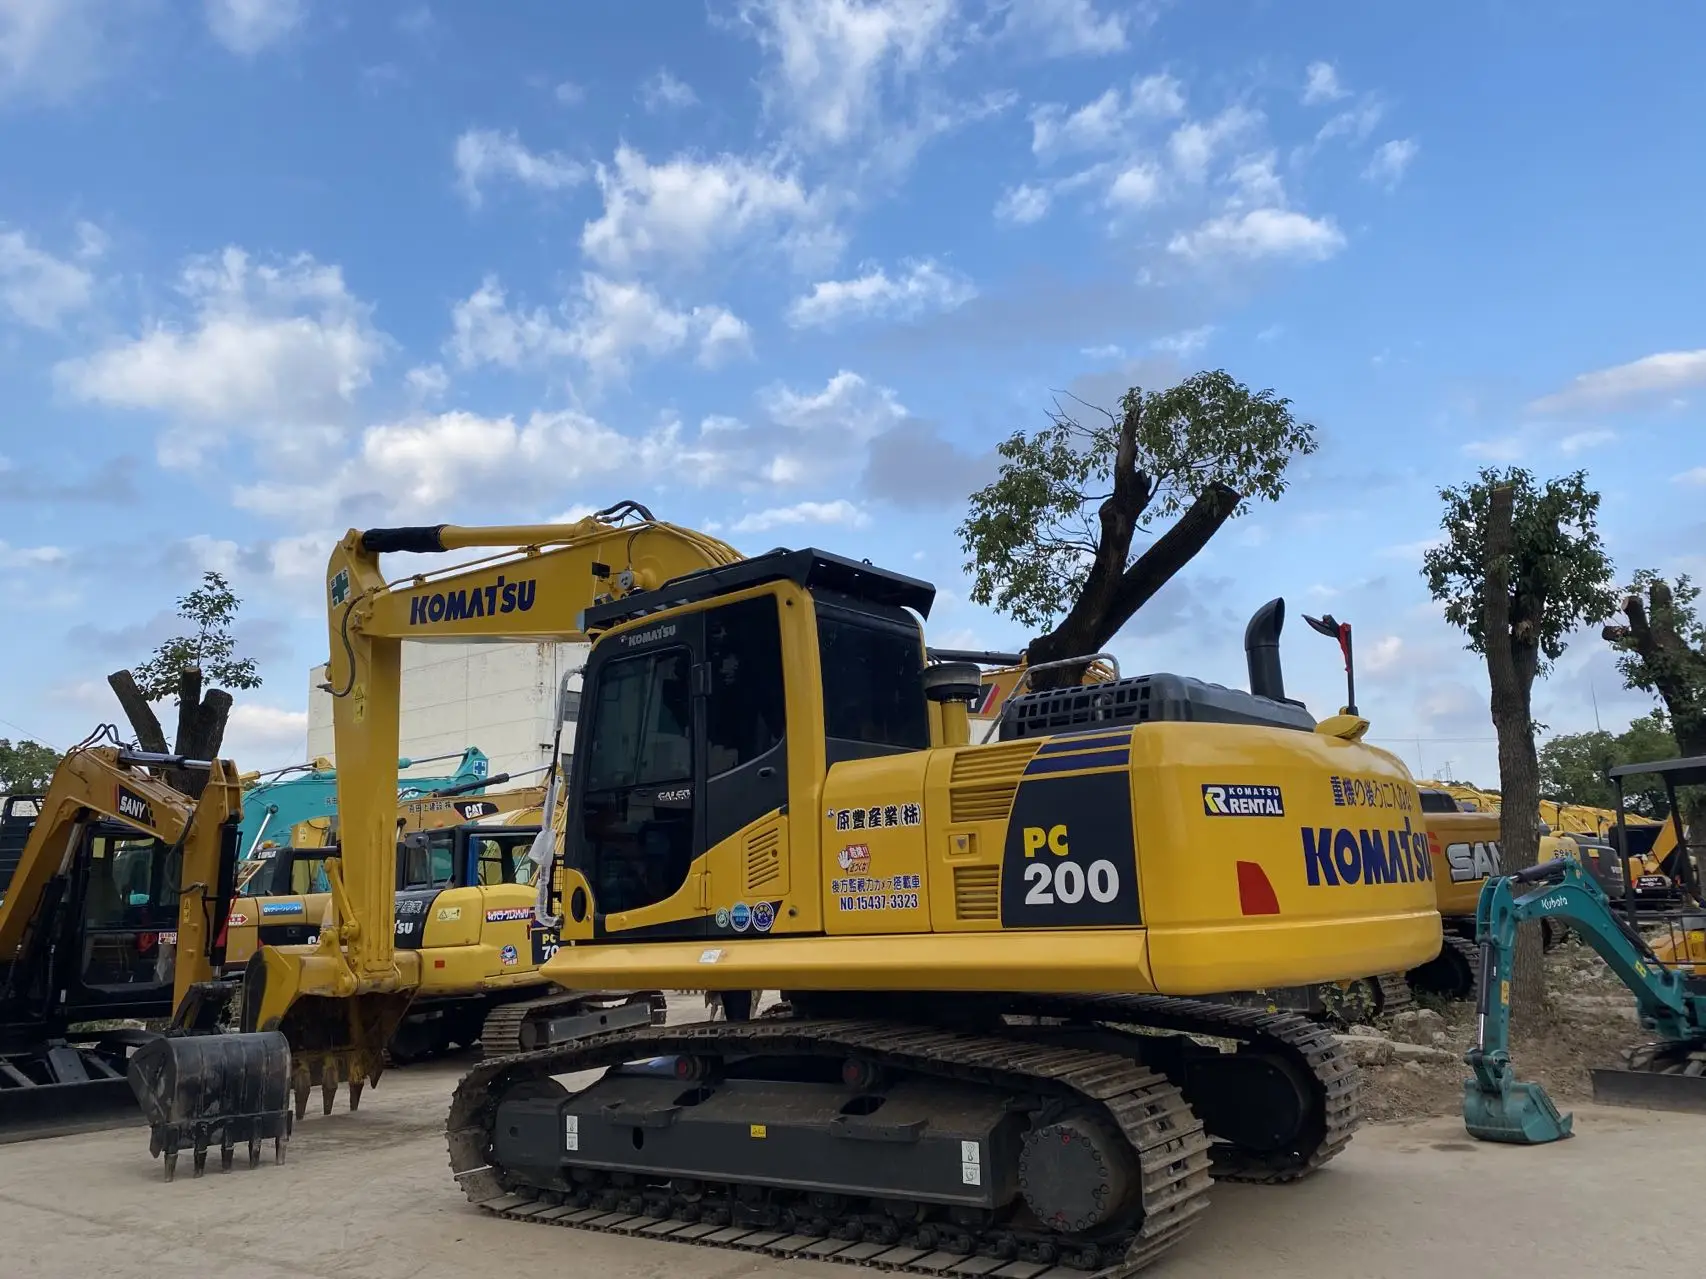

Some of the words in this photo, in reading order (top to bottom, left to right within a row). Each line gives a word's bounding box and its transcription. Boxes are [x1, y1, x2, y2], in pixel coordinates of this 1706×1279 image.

[410, 576, 536, 625] KOMATSU
[628, 625, 676, 646] KOMATSU
[1228, 787, 1279, 796] KOMATSU
[119, 795, 146, 818] SANY
[465, 803, 483, 818] CAT
[1229, 798, 1283, 814] RENTAL
[1023, 824, 1069, 857] PC
[1301, 816, 1433, 886] KOMATSU
[1447, 842, 1500, 882] SAN
[1024, 859, 1119, 905] 200
[1541, 895, 1568, 910] Kubota
[542, 933, 556, 944] PC
